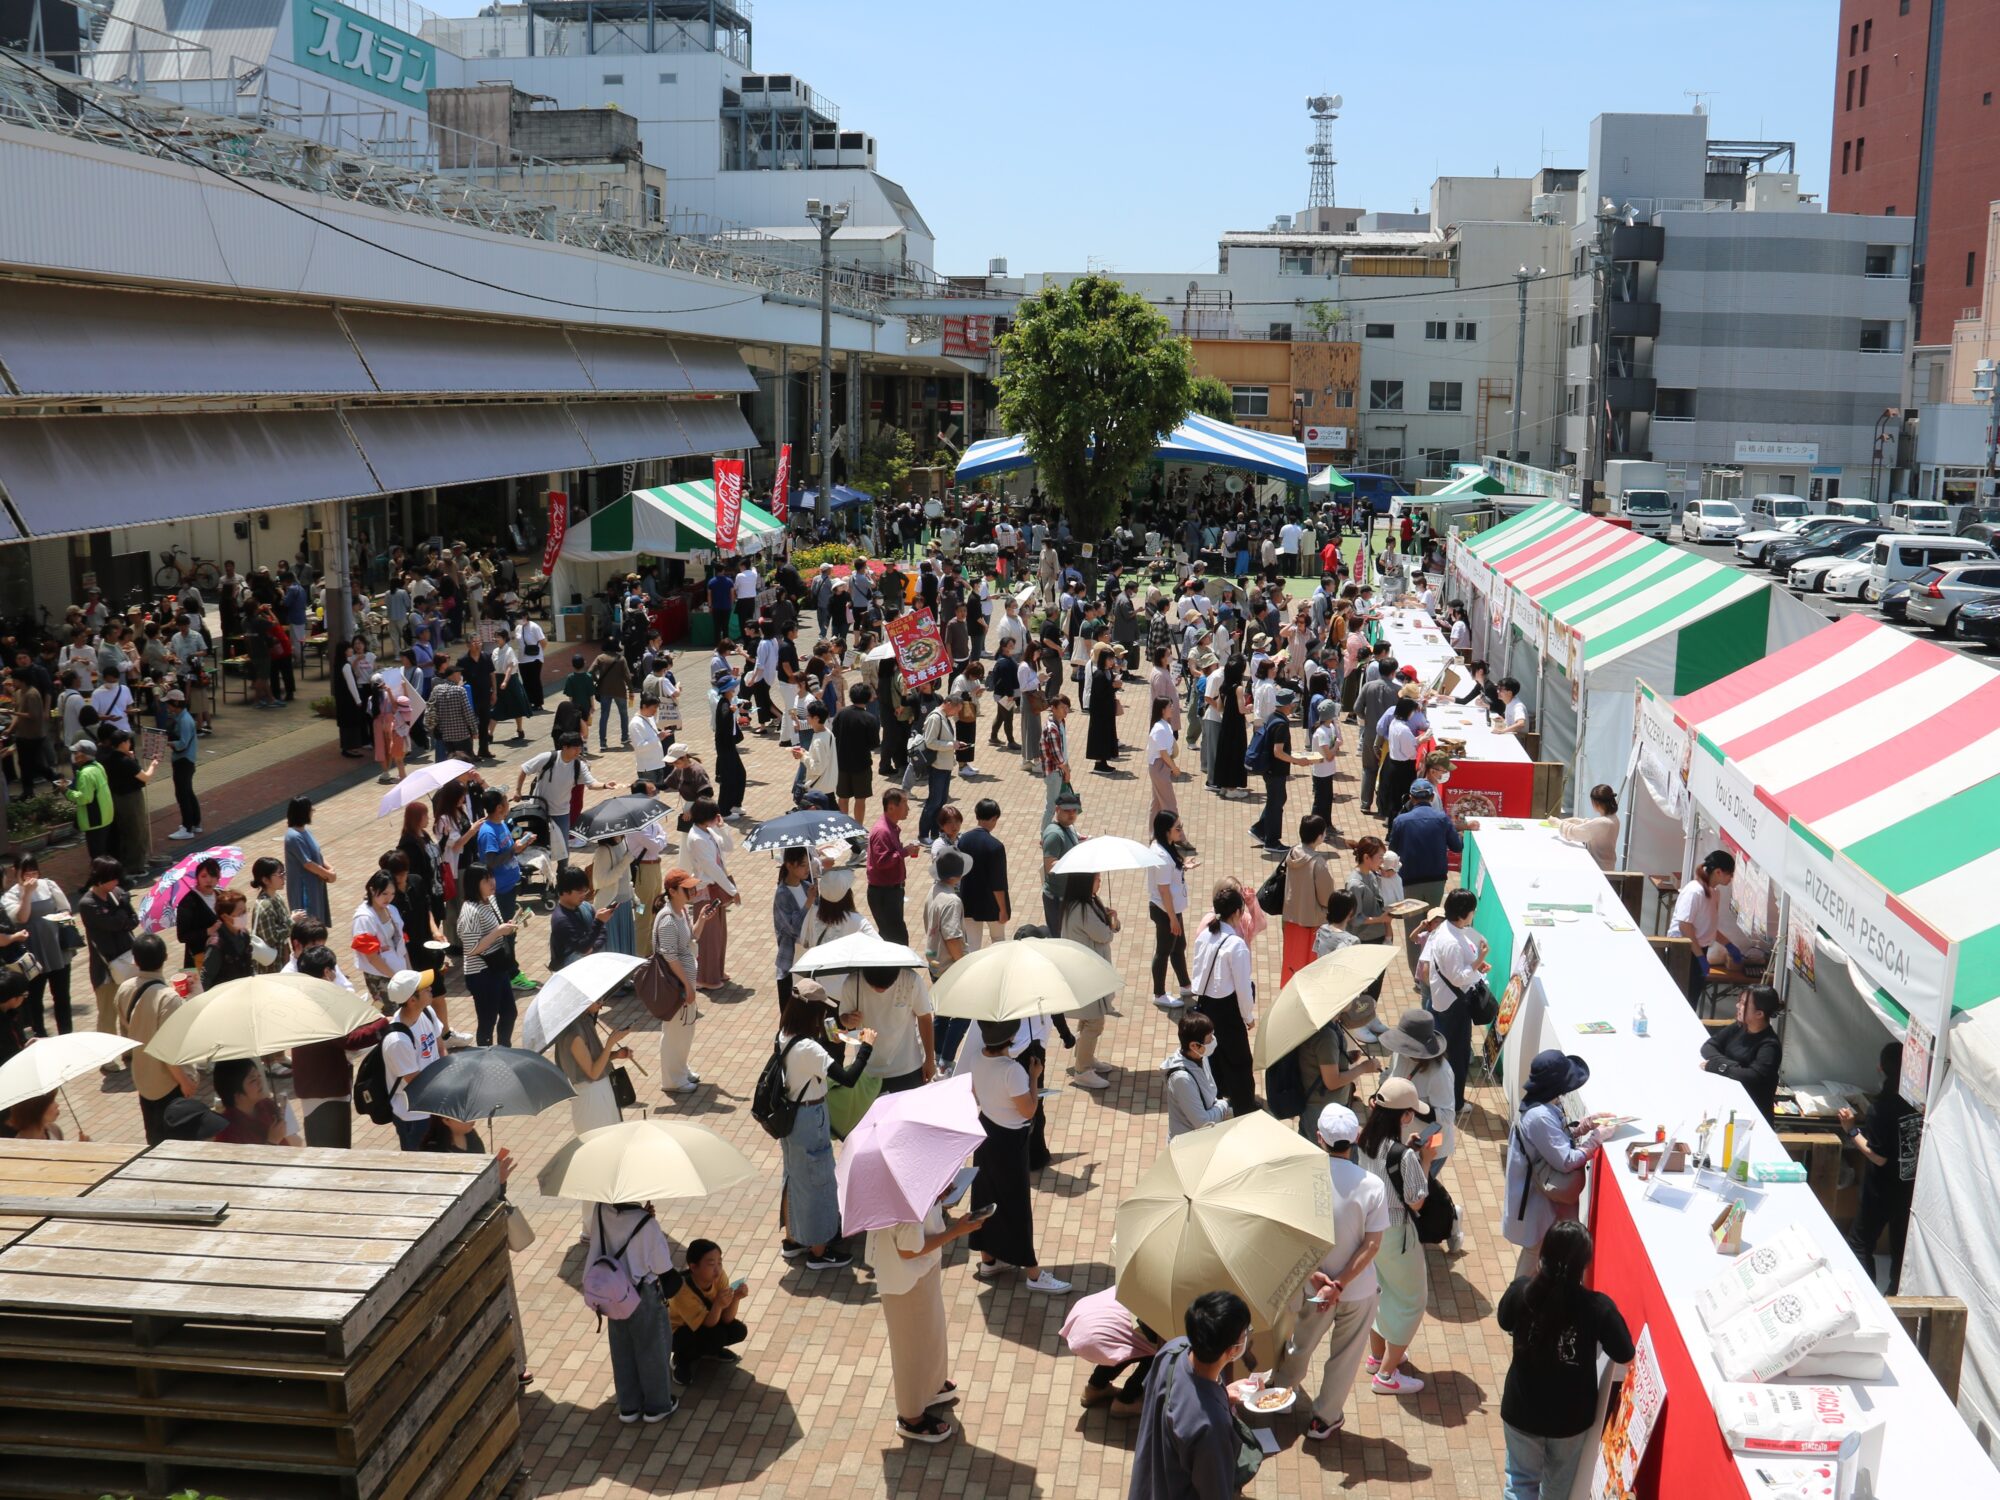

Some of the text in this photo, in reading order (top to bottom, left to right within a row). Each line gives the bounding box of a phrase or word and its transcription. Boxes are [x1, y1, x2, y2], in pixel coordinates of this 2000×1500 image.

[308, 6, 429, 94] スズラン
[1643, 713, 1665, 745] PIZZERIA
[1715, 776, 1757, 840] You's Dining
[1804, 868, 1910, 986] PIZZERIA PESCA!
[1810, 1386, 1846, 1425] STACCATO
[1801, 1442, 1828, 1452] STACCATO
